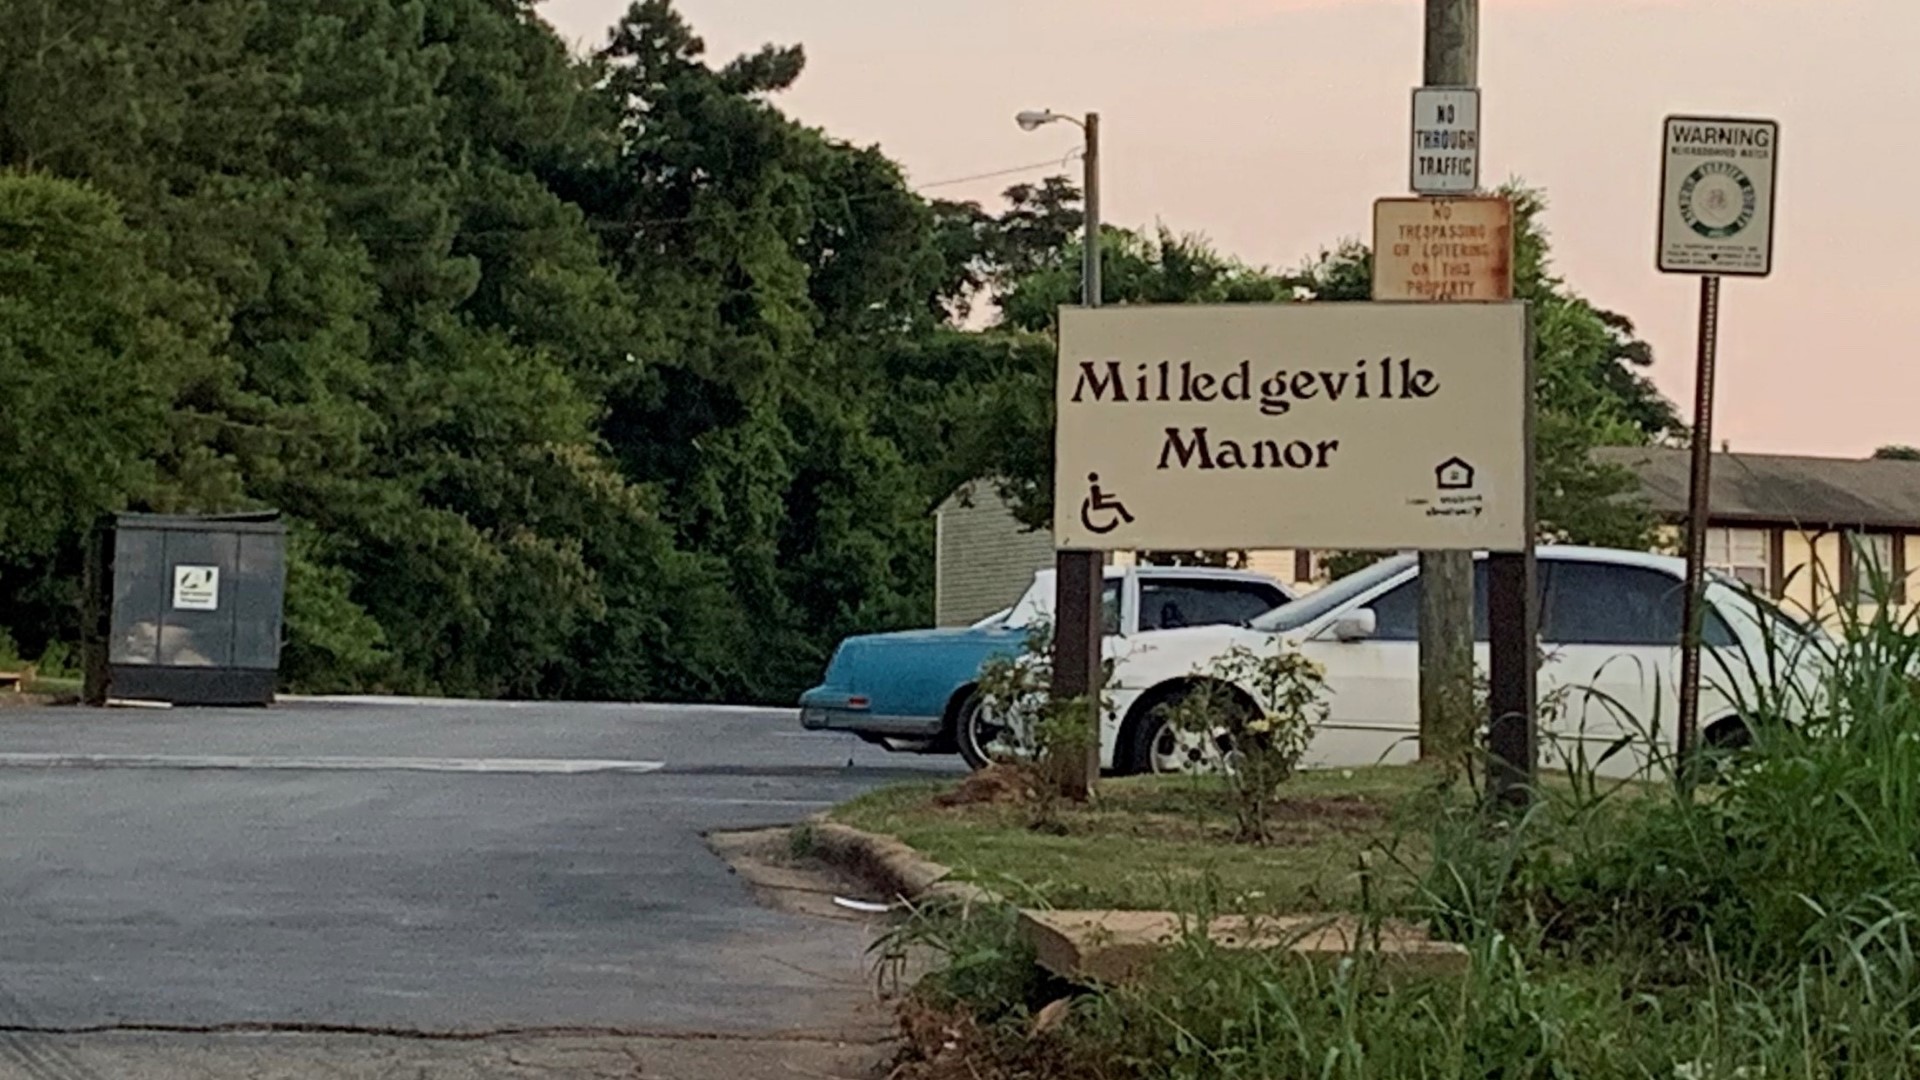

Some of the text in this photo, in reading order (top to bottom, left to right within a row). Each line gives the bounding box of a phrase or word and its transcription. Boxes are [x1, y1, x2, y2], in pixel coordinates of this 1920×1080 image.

[1436, 104, 1455, 124] NO
[1416, 130, 1476, 150] THROUGH
[1673, 125, 1769, 147] WARNING
[1419, 157, 1472, 176] TRAFFIC
[1432, 206, 1451, 220] NO
[1399, 225, 1485, 240] TRESPASSING
[1411, 262, 1429, 276] ON
[1071, 357, 1440, 416] Milledgeville
[1156, 427, 1340, 470] Manor
